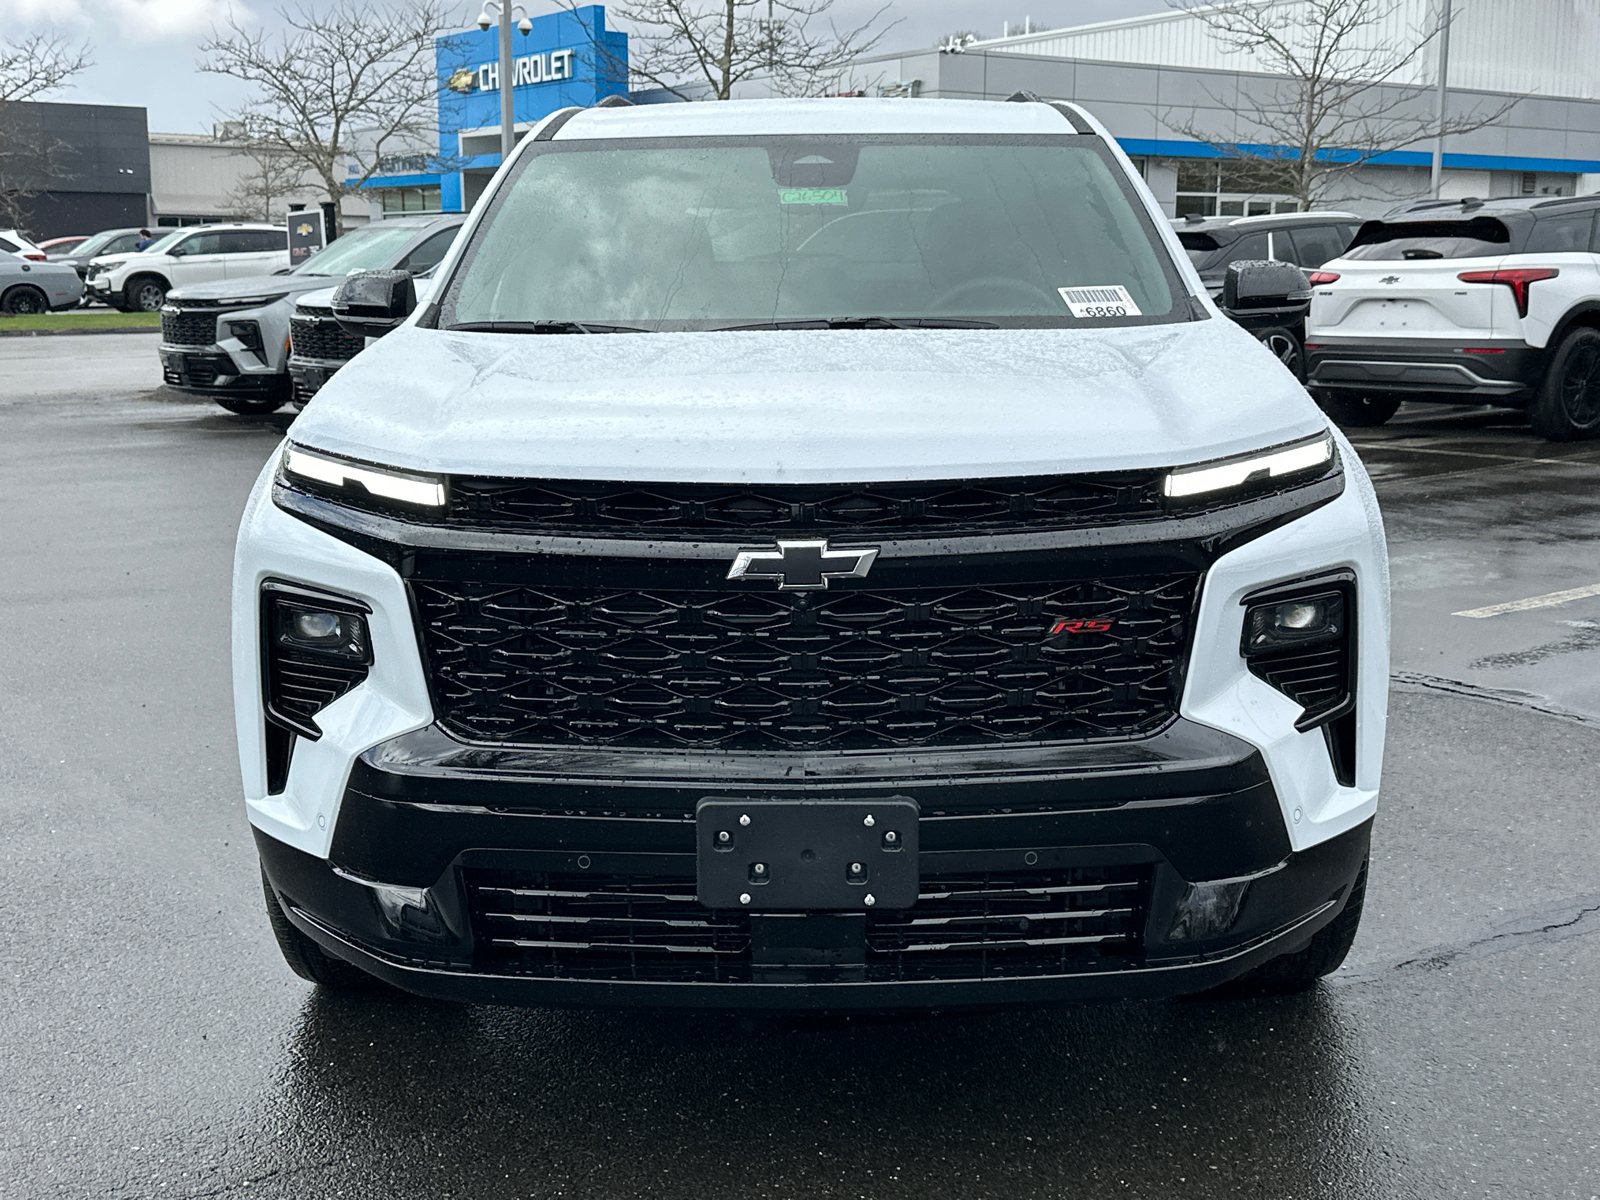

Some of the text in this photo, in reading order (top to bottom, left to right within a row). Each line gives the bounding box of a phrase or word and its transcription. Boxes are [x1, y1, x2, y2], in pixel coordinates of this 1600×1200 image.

[478, 49, 573, 91] CHVROLET
[1085, 305, 1127, 317] 6860
[1048, 618, 1115, 634] RS
